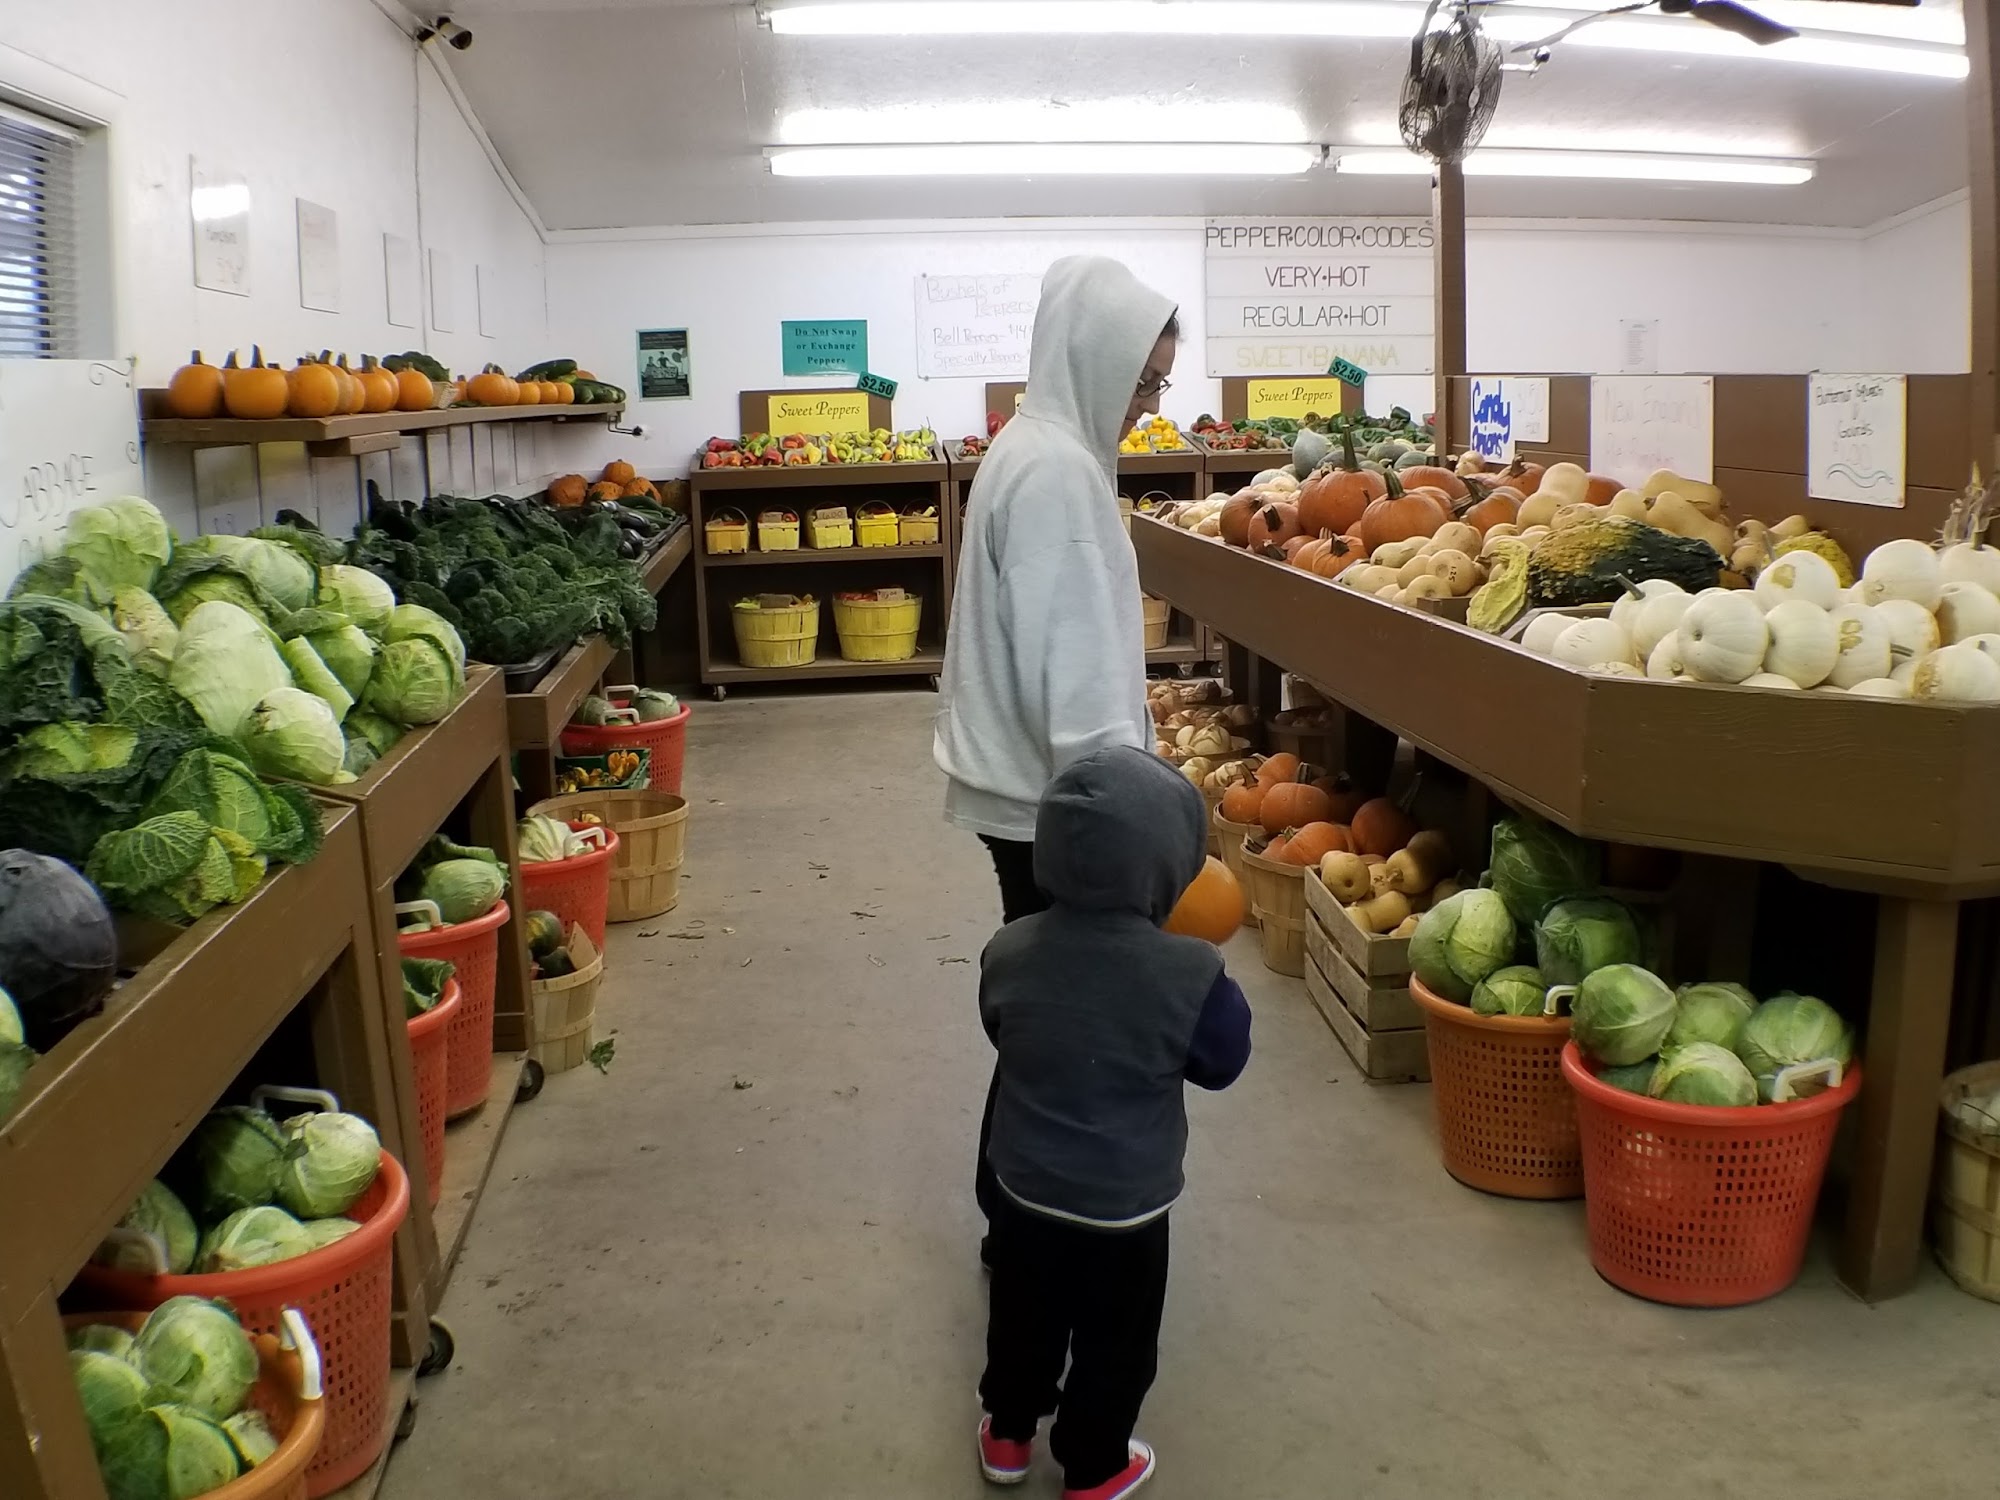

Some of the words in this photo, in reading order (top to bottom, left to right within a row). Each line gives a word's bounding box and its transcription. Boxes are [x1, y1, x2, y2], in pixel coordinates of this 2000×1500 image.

[1205, 226, 1289, 249] PEPPER
[1293, 226, 1356, 248] COLOR
[1361, 226, 1435, 248] CODES
[1264, 265, 1322, 288] VERY
[1328, 265, 1371, 288] HOT
[1243, 305, 1342, 328] REGULAR
[1349, 305, 1392, 327] HOT
[794, 328, 808, 337] Do
[812, 328, 829, 337] Not
[831, 328, 858, 338] Swap
[933, 325, 960, 345] Bell
[811, 341, 856, 351] Exchange
[807, 355, 846, 365] Peppers
[1236, 345, 1305, 369] SWEET
[1331, 360, 1363, 385] $2.50
[859, 375, 894, 396] $2.50
[1254, 387, 1289, 404] Sweet
[1291, 386, 1334, 405] Peppers
[777, 402, 812, 419] Sweet
[815, 401, 861, 419] Peppers
[1472, 380, 1511, 444] Candy
